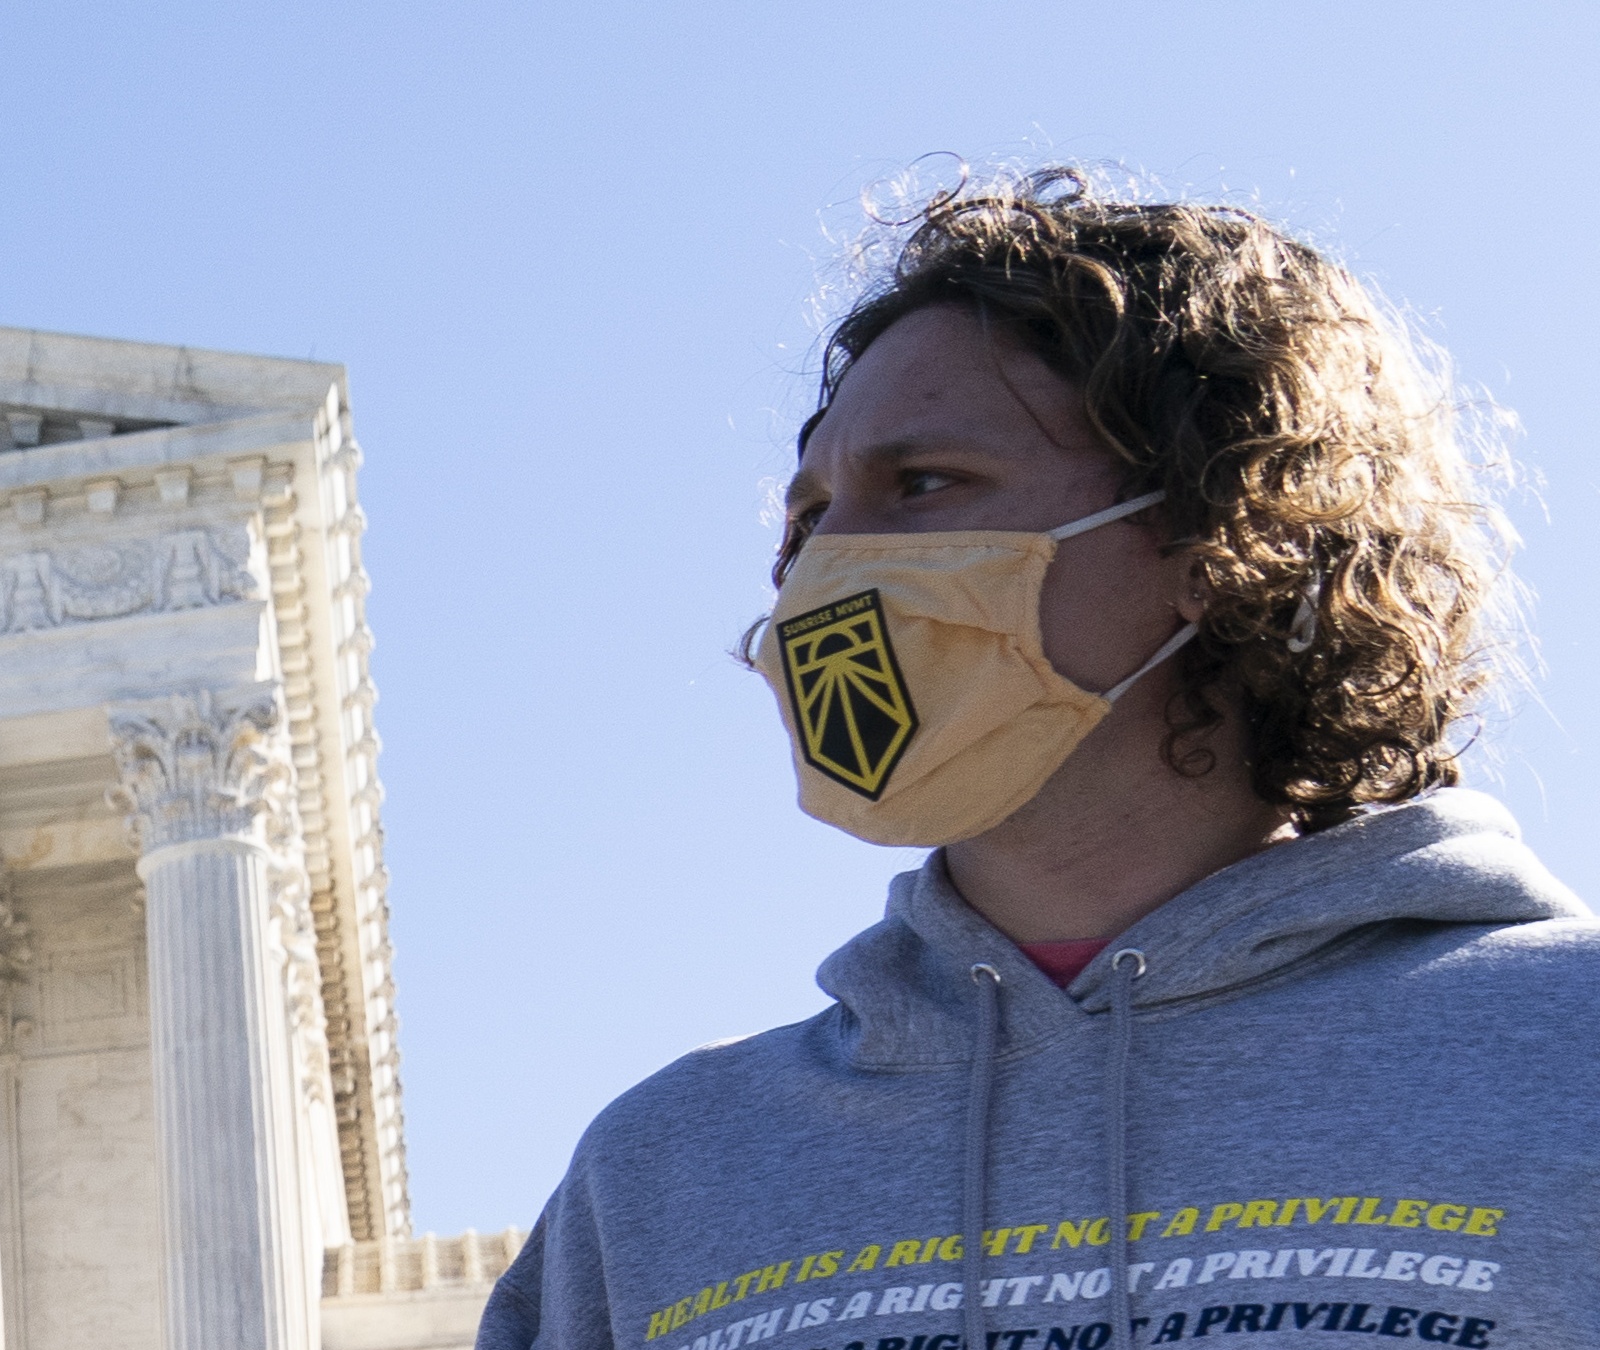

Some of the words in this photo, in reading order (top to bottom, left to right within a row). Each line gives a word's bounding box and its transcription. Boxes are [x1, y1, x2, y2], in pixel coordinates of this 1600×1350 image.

[645, 1260, 793, 1342] HEALTH
[795, 1250, 844, 1283] IS
[847, 1244, 882, 1273] A
[884, 1224, 1049, 1268] RIGHT
[1052, 1211, 1160, 1249] NOT
[1159, 1207, 1200, 1238] A
[1203, 1197, 1504, 1236] PRIVILEGE
[785, 1297, 837, 1332] IS
[835, 1291, 873, 1321] A
[1043, 1262, 1155, 1303] NOT
[1153, 1257, 1194, 1290] A
[1196, 1248, 1501, 1292] PRIVILEGE
[1151, 1311, 1188, 1345] A
[1193, 1302, 1496, 1350] PRIVILEGE
